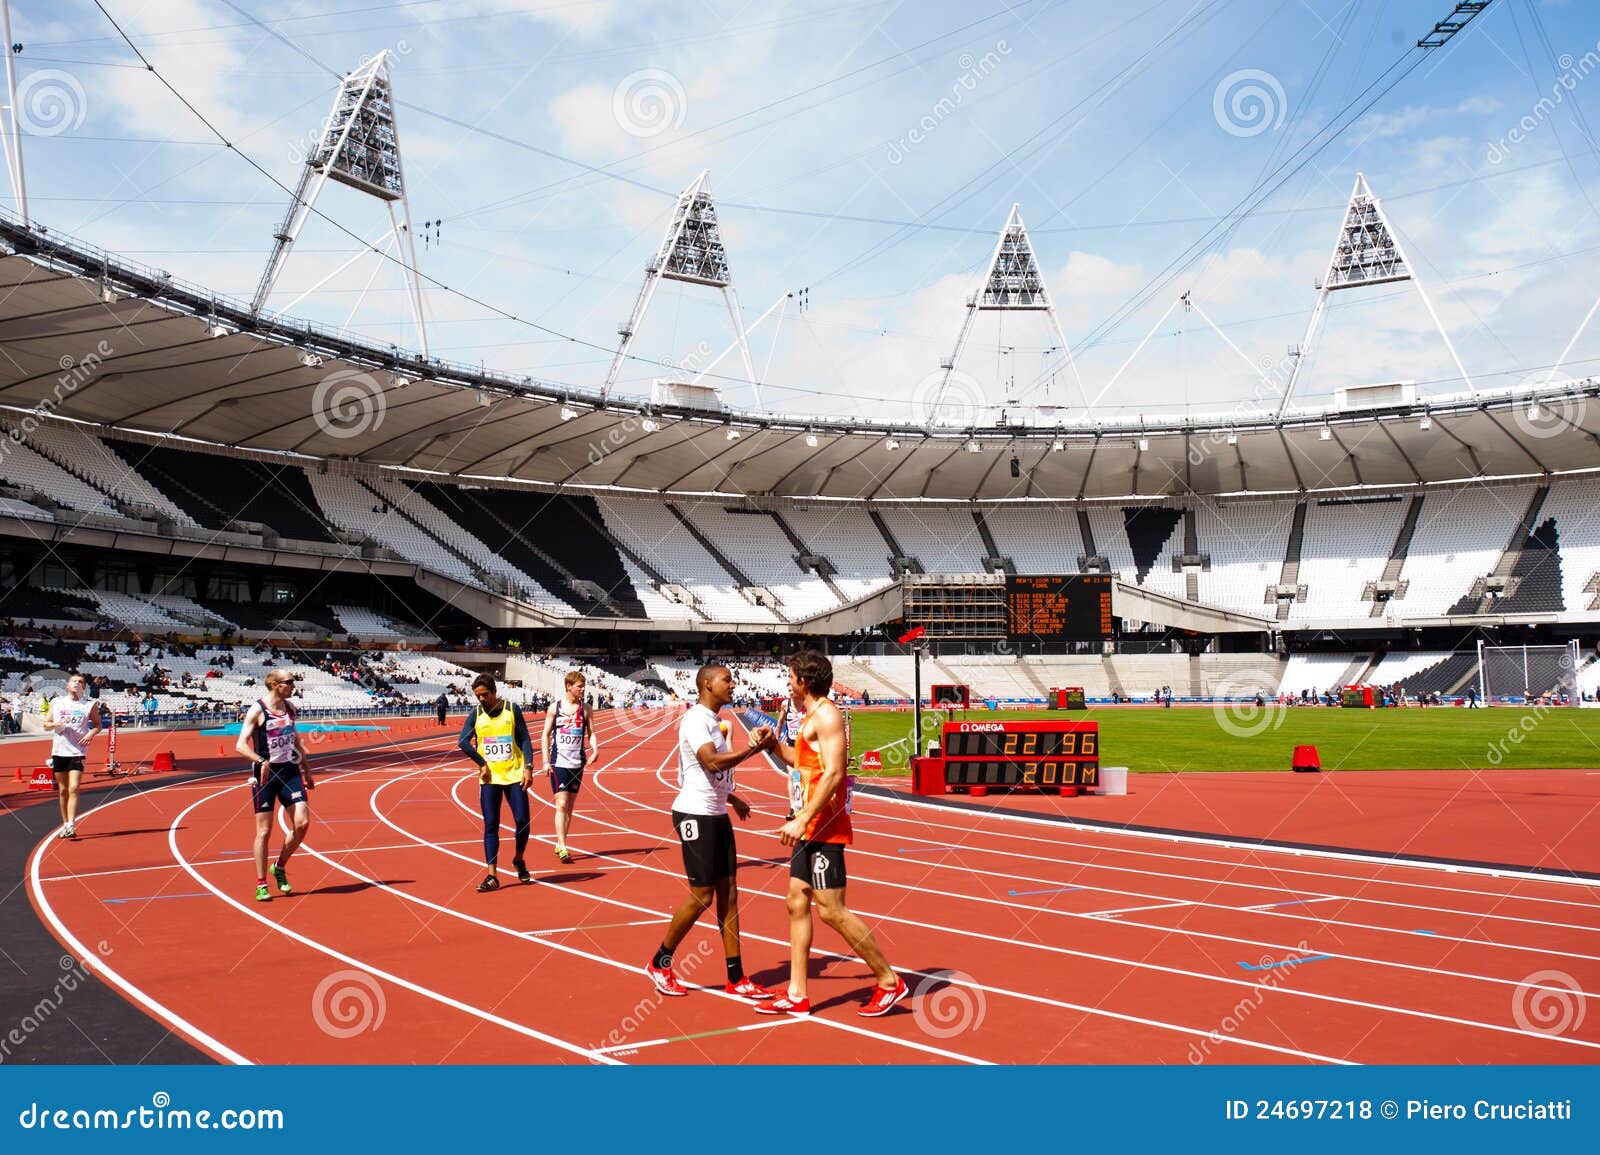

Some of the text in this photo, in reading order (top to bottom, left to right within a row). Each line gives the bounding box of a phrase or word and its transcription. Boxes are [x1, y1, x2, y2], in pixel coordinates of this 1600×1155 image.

[971, 723, 1005, 732] OMEGA
[560, 735, 582, 745] 5077
[485, 743, 513, 756] 5013
[1023, 763, 1096, 784] 200M
[685, 822, 693, 839] 8
